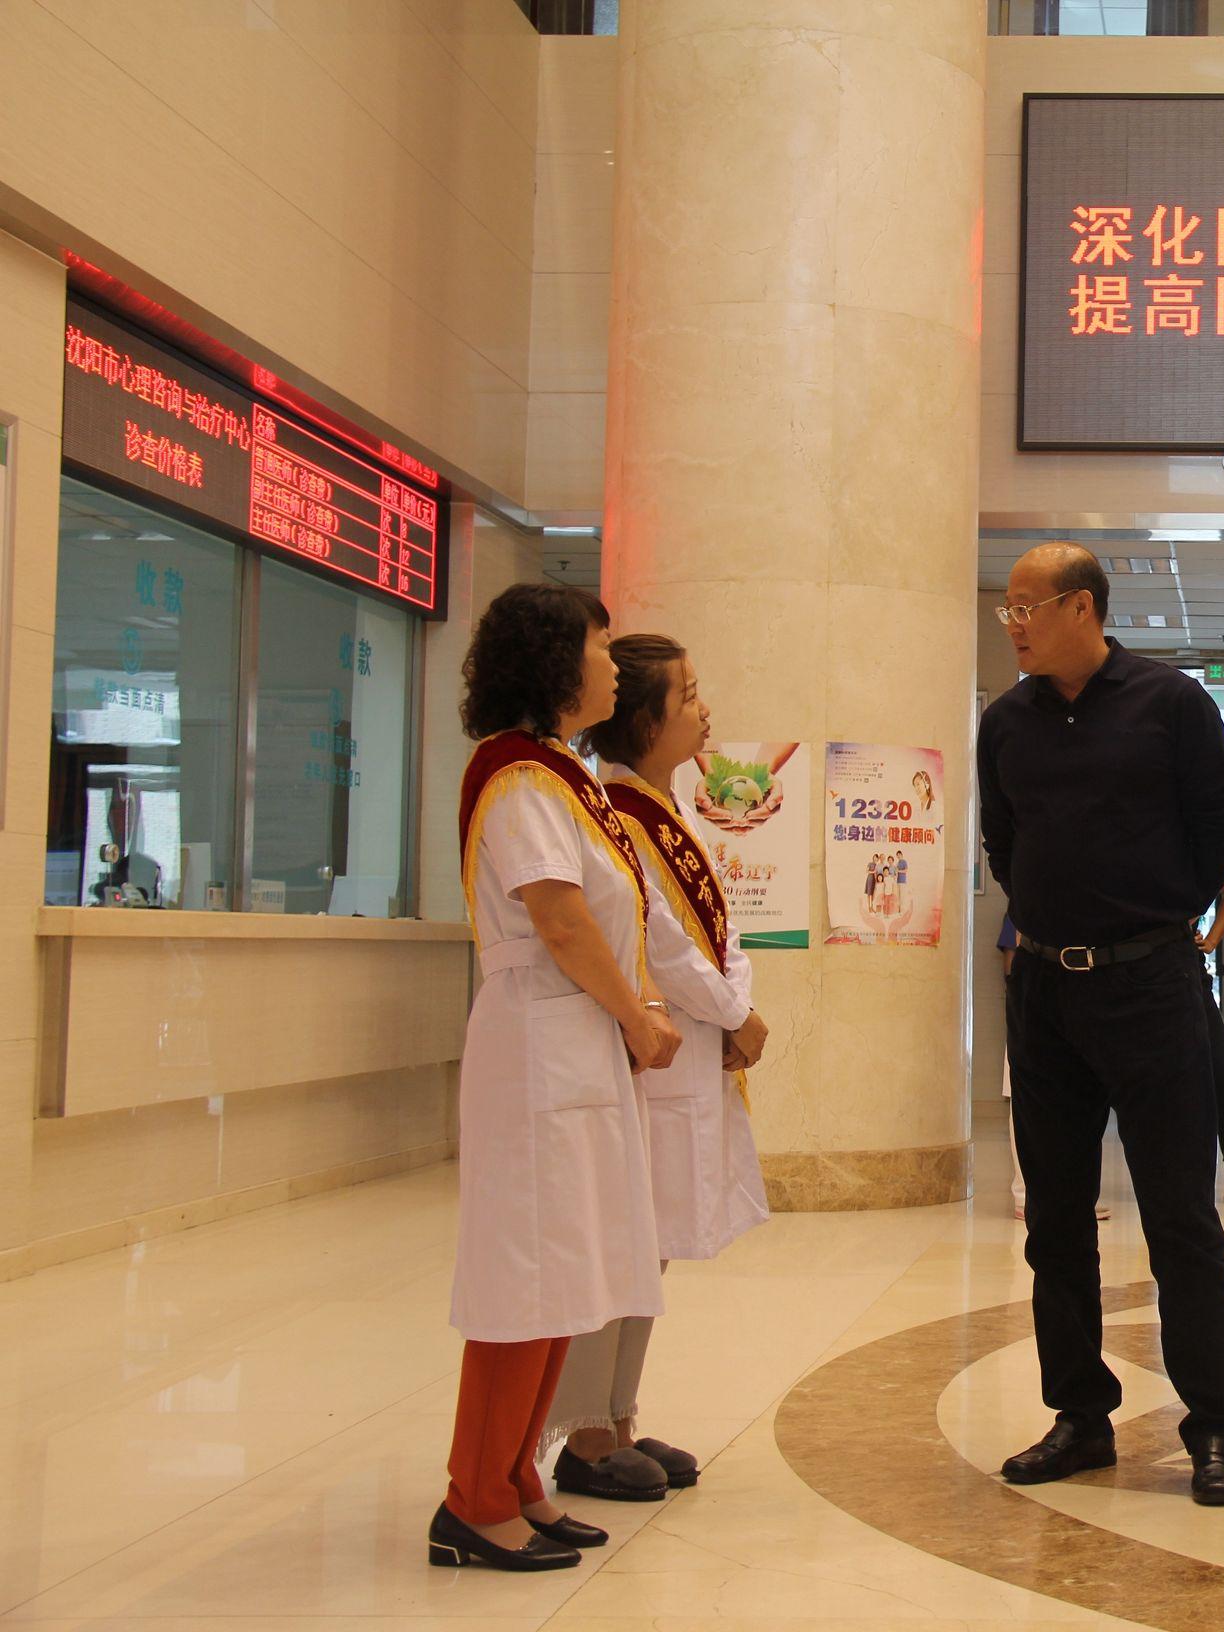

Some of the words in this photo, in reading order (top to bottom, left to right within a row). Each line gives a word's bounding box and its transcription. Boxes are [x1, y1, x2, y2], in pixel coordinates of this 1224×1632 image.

[66, 325, 251, 453] 沈阳市心理咨询与治疗中心
[256, 412, 277, 442] 名称
[125, 420, 203, 488] 诊查价格表
[835, 798, 912, 821] 12320
[833, 824, 935, 845] 您身边的健康顾问
